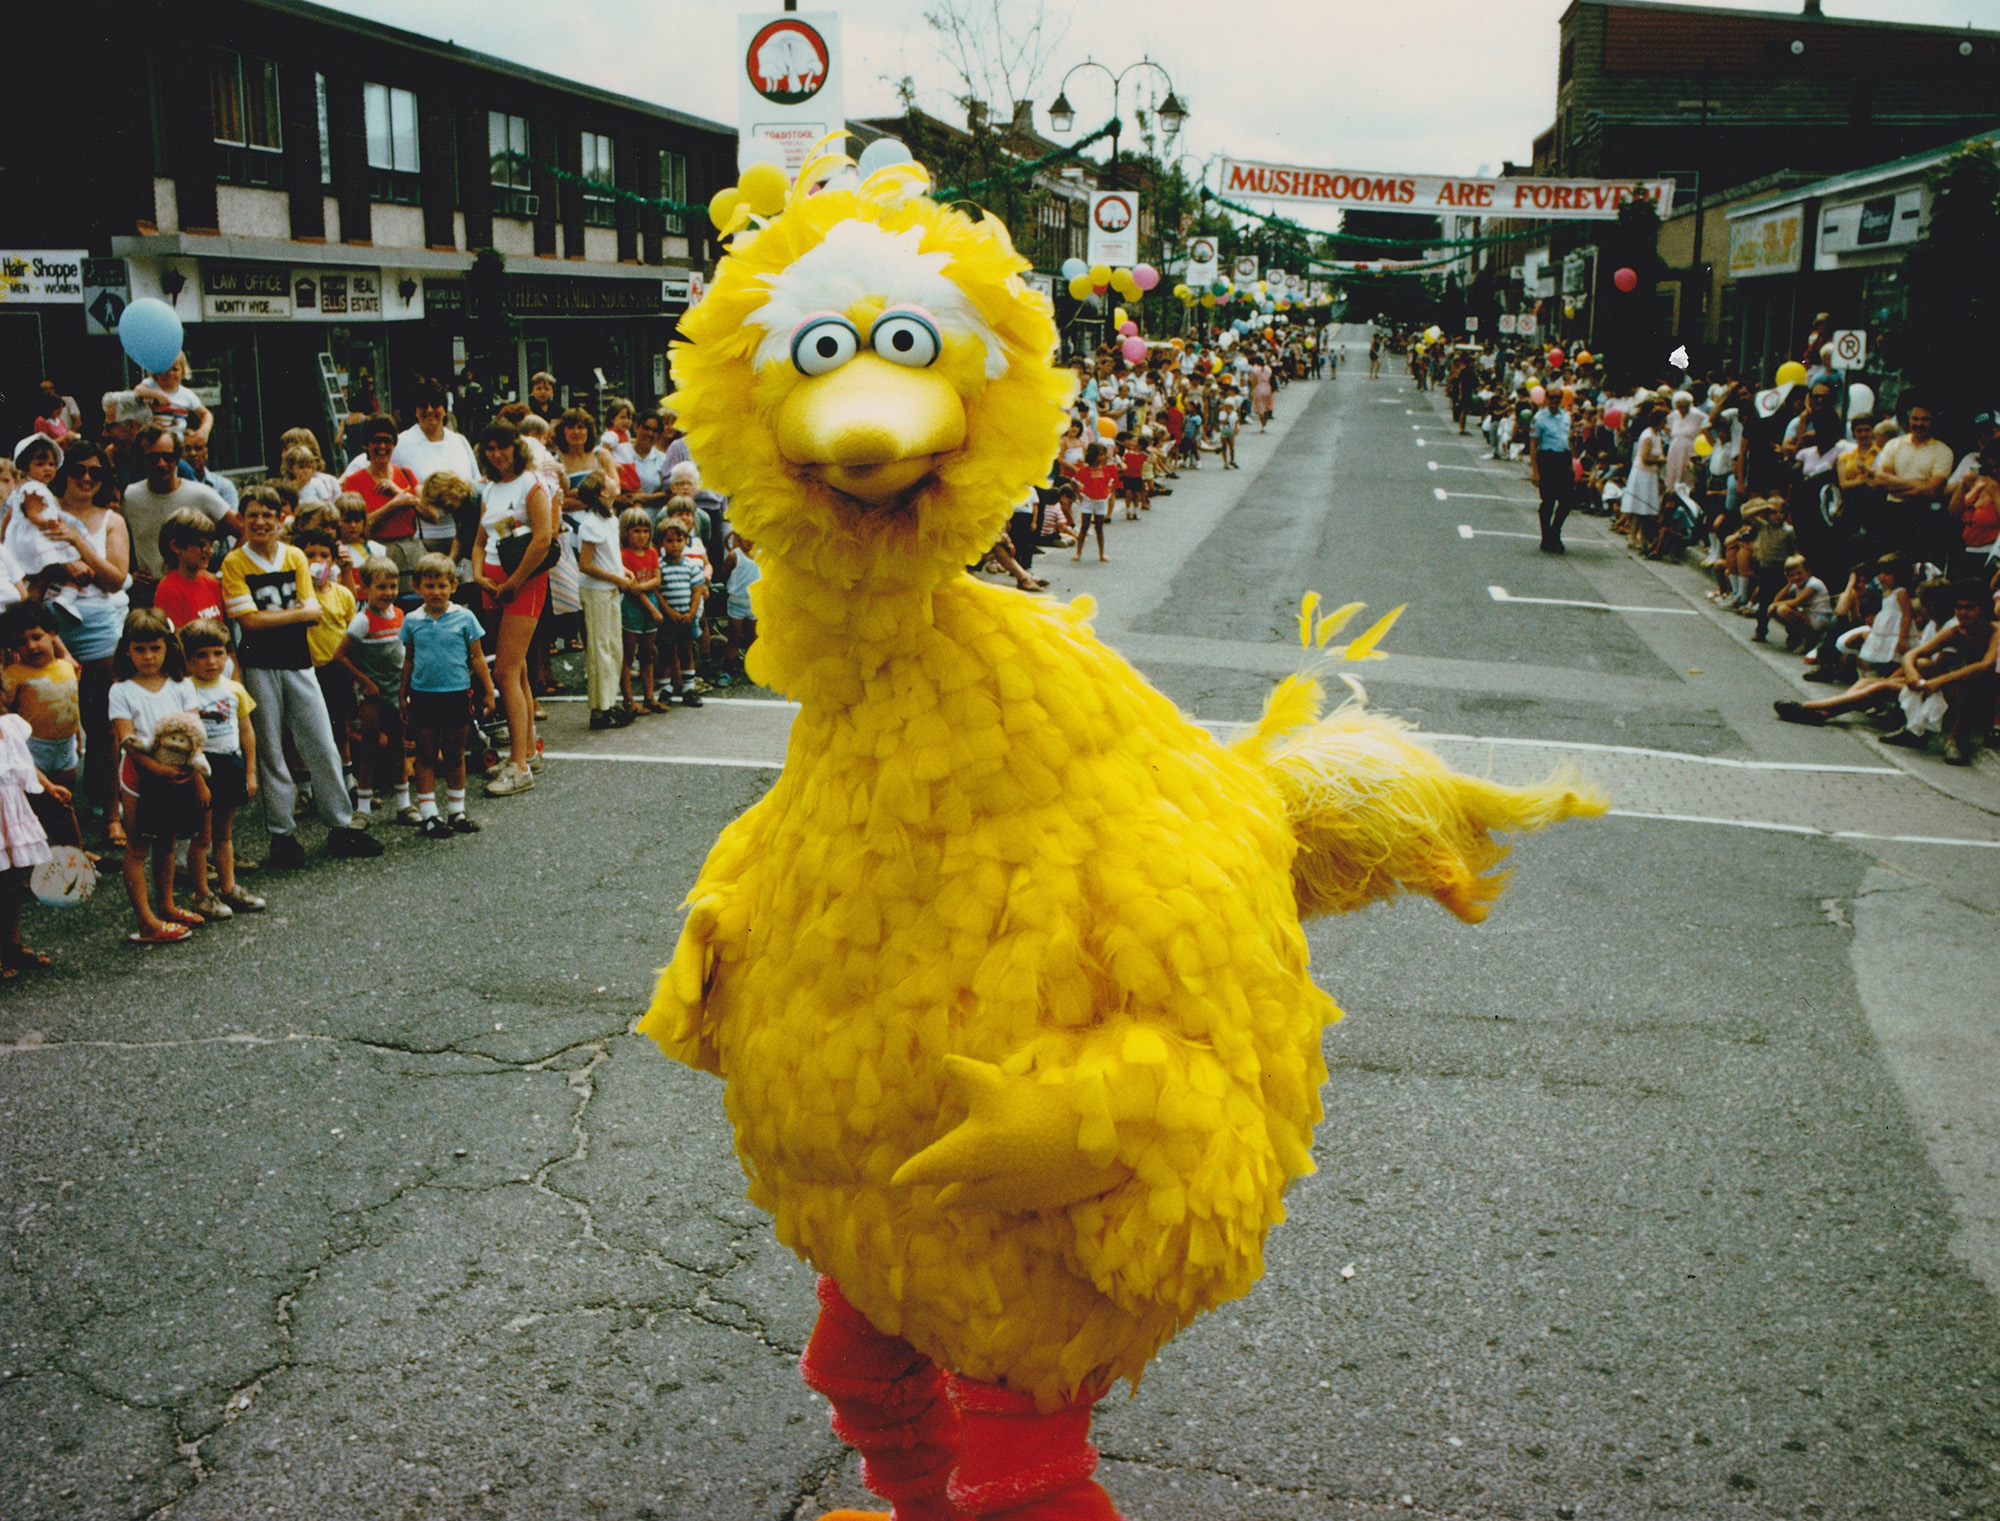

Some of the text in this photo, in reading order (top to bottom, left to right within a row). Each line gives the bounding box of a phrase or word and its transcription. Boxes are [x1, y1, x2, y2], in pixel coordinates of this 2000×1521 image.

[764, 130, 814, 139] TOADSTOOL
[1228, 165, 1416, 204] MUSHROOMS
[1435, 181, 1495, 208] ARE
[2, 257, 28, 278] Hair
[32, 257, 78, 285] Shoppe
[9, 283, 80, 294] MEN WOMEN
[211, 273, 282, 292] LAW OFFICE
[353, 277, 376, 294] REAL
[214, 300, 246, 313] MONTY
[248, 301, 269, 313] HYDE
[323, 294, 346, 310] ELLIS
[351, 297, 379, 312] ESTATE
